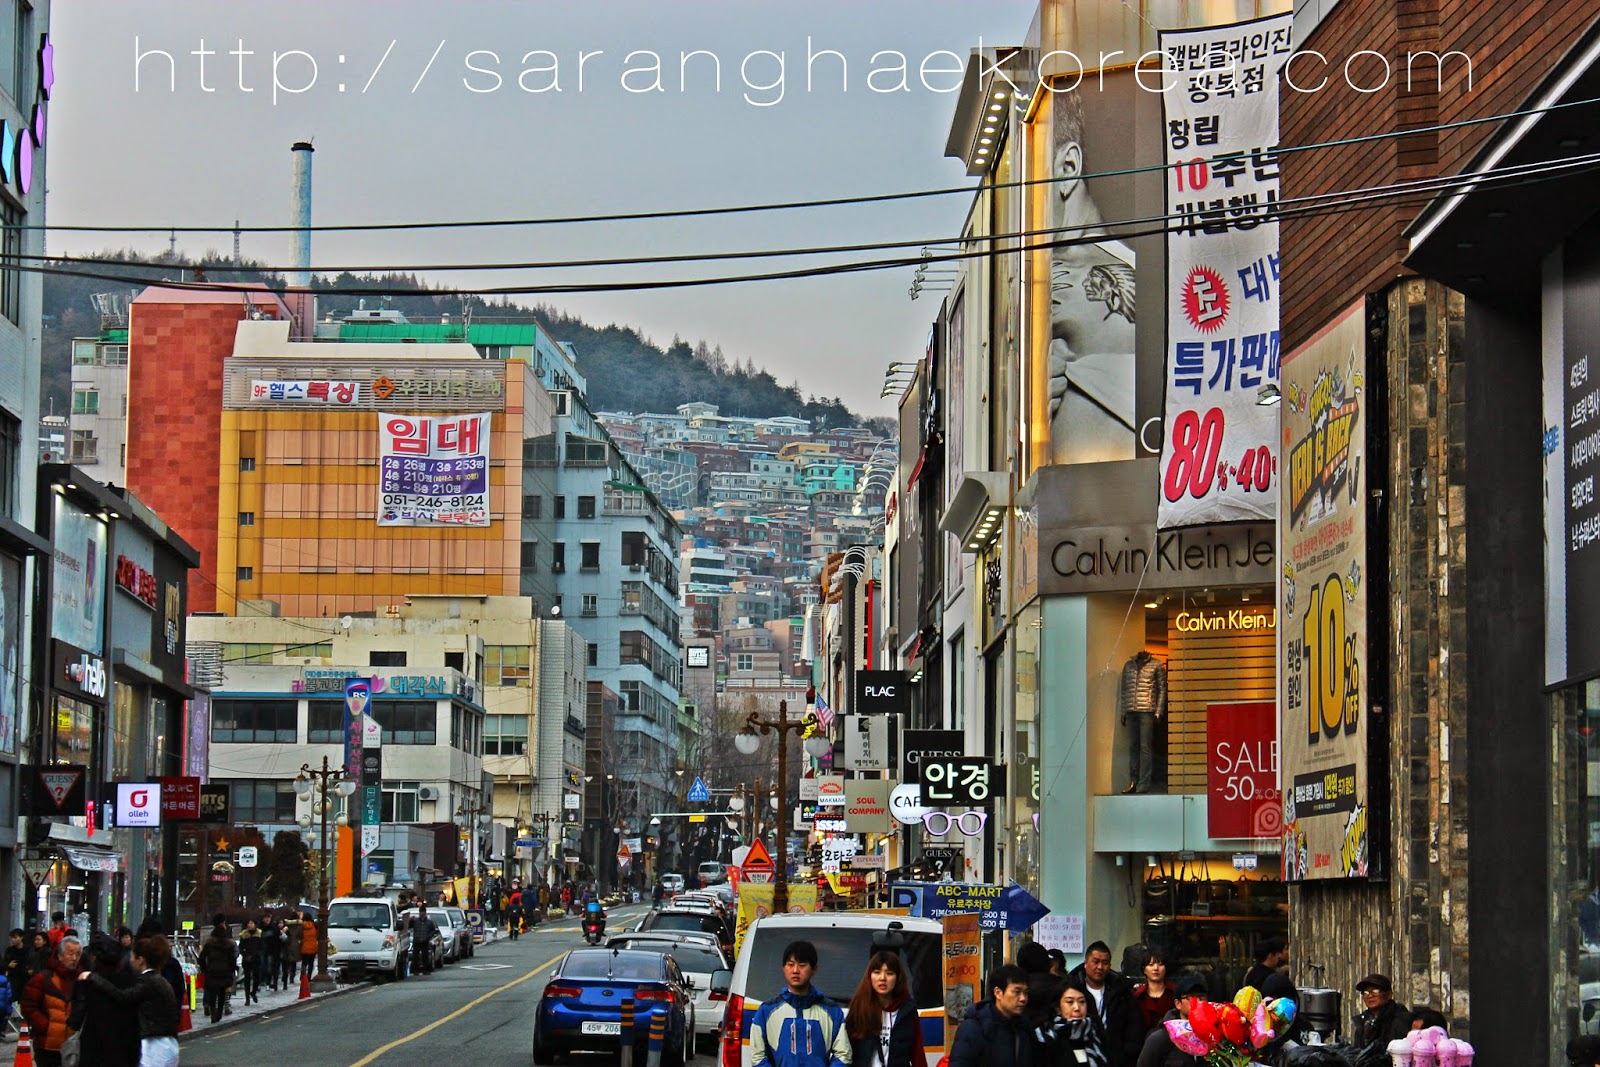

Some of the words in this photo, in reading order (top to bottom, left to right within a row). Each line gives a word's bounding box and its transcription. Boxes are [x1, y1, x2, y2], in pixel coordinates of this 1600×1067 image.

[1187, 63, 1265, 104] 광복점
[1168, 114, 1220, 150] 창립
[386, 417, 481, 456] 임대
[382, 494, 484, 508] 051-246-8124
[401, 511, 435, 523] 박사
[437, 511, 487, 525] 부동산
[1051, 537, 1149, 577] Calvin
[1156, 532, 1231, 572] Klein
[1175, 610, 1225, 633] Calvin
[1228, 608, 1266, 631] Klein
[390, 675, 447, 697] 대각사
[864, 685, 896, 698] PLAC
[44, 774, 74, 783] GUESS
[924, 763, 989, 800] 안경
[856, 797, 876, 805] SOUL
[893, 795, 922, 808] CAF
[128, 809, 149, 818] olleh
[848, 807, 885, 815] COMPANY
[925, 849, 952, 858] GUESS
[24, 861, 50, 870] GUESS
[935, 885, 1004, 898] ABC-MART
[946, 898, 993, 910] 유료주차장
[604, 1024, 621, 1034] 206
